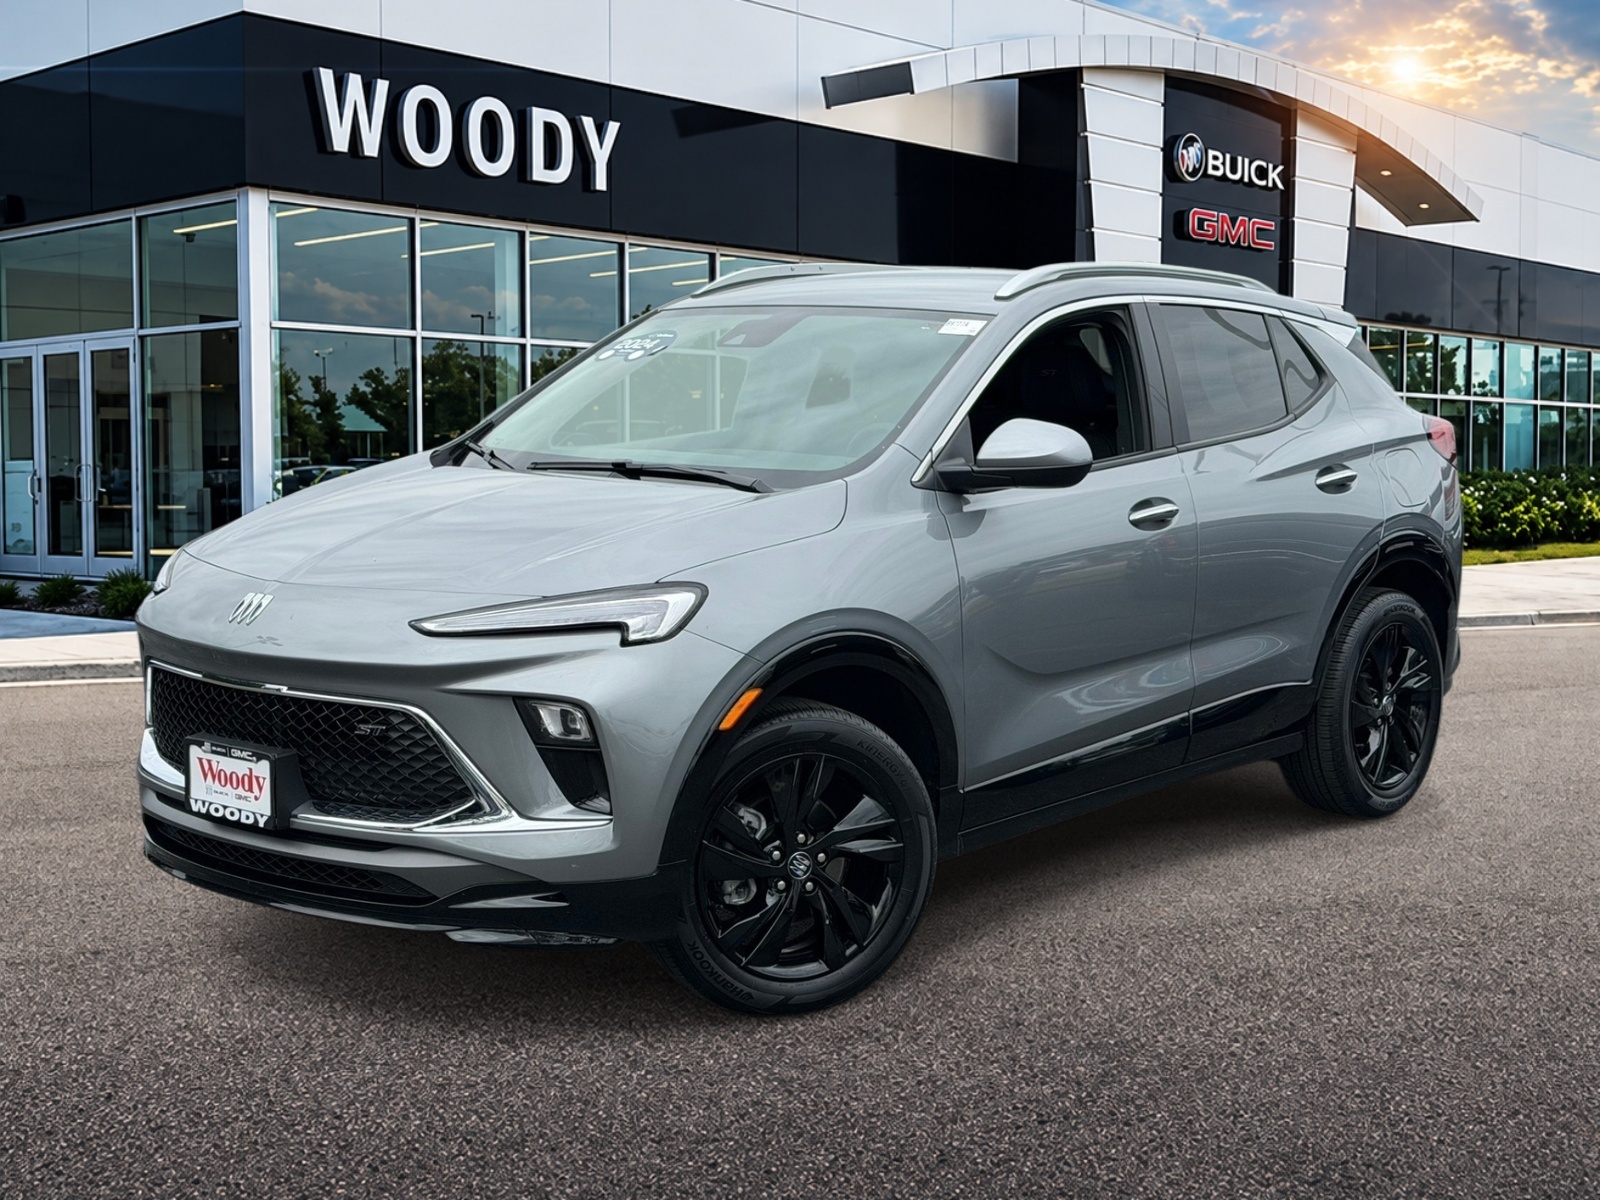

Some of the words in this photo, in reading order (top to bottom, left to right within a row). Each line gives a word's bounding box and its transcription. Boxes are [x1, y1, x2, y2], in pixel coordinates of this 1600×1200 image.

[313, 66, 621, 191] WOODY
[1206, 148, 1285, 190] BUICK
[1189, 207, 1275, 250] GMC
[354, 722, 386, 736] ST
[231, 748, 253, 760] GMC
[196, 756, 267, 802] Woody
[189, 798, 269, 828] WOODY
[235, 793, 252, 803] GMC
